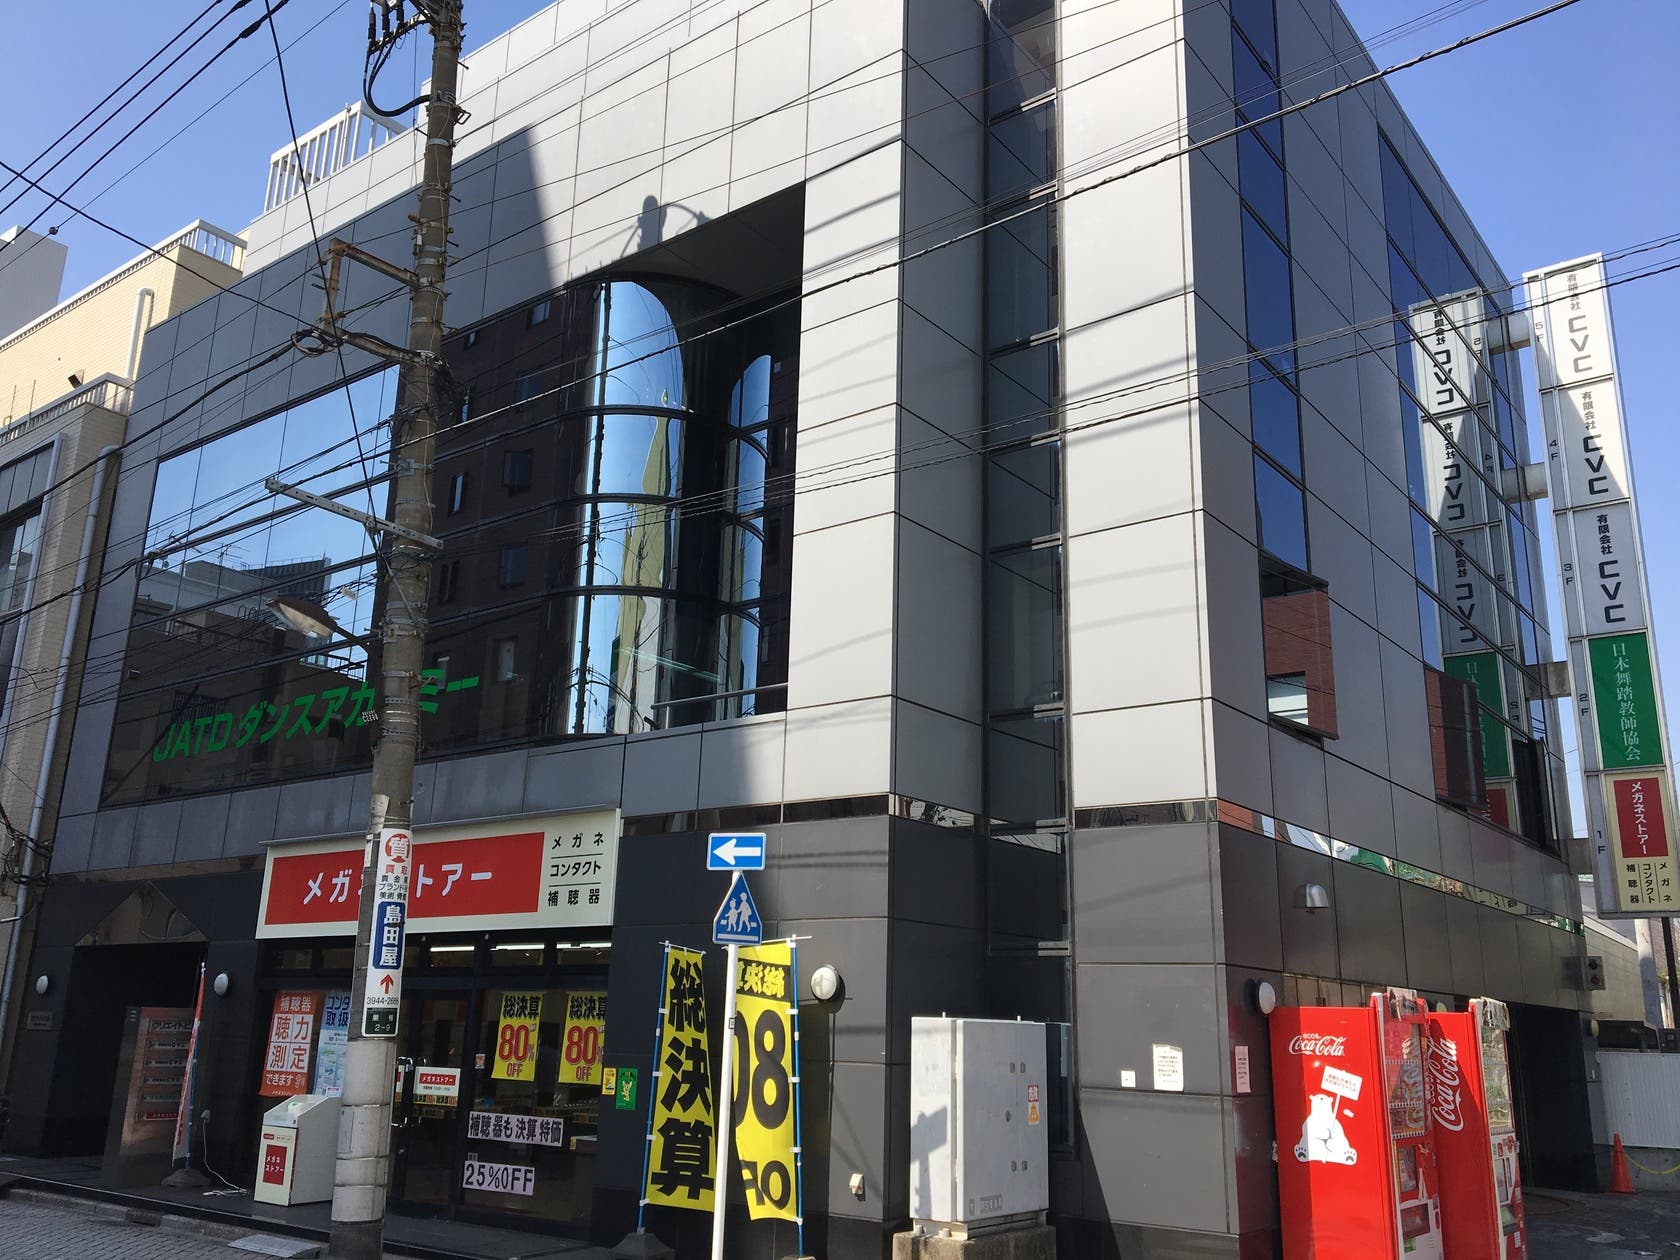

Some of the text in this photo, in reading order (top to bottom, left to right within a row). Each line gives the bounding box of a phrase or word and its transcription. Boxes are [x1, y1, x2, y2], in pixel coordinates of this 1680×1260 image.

[1535, 322, 1544, 342] 5F
[1568, 315, 1593, 373] CVC
[1549, 439, 1559, 461] 4F
[1582, 391, 1609, 495] 有限会社 CVC
[1564, 563, 1573, 586] 3F
[1597, 514, 1626, 623] 有限会社 CVC
[1579, 693, 1589, 717] 2F
[1612, 642, 1641, 761] 日本舞踏教師協会
[152, 668, 481, 763] JATD ダンスアカミー
[1631, 781, 1649, 855] メガネストアー
[551, 831, 604, 850] メガネ
[1597, 830, 1606, 855] 1F
[549, 860, 602, 877] コンタクト
[303, 862, 493, 905] メガトアー
[1625, 863, 1640, 904] 補聴器
[1642, 863, 1656, 904] コンタクト
[1659, 861, 1673, 903] メガネ
[547, 888, 600, 907] 補聴器
[380, 904, 402, 966] 島田屋
[503, 996, 541, 1019] 総決算
[275, 1015, 310, 1040] 聴力
[374, 1023, 391, 1032] 2-9
[270, 1044, 307, 1070] 測定
[506, 1062, 523, 1078] OFF
[575, 1065, 593, 1082] OFF
[651, 957, 715, 1200] 総決算
[464, 1163, 534, 1192] 25%OFF
